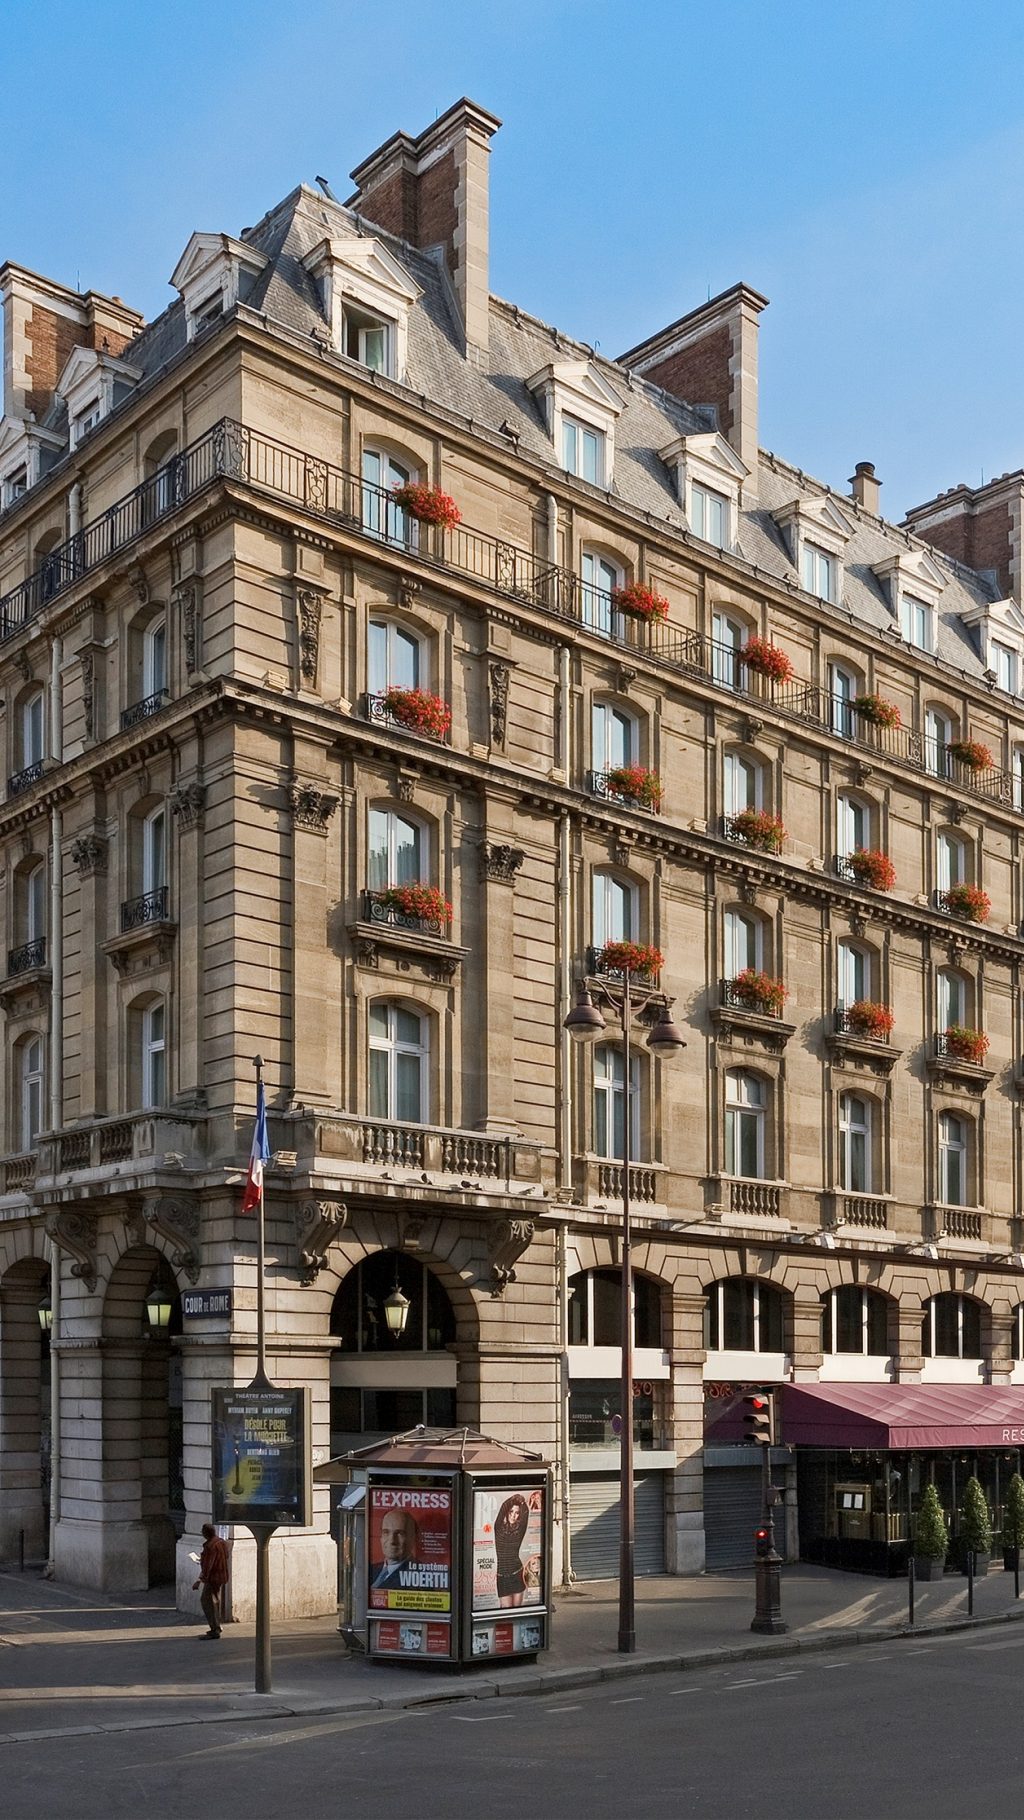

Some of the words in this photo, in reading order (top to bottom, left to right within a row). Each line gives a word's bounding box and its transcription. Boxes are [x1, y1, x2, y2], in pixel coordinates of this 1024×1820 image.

[185, 1297, 203, 1313] COUR
[210, 1295, 229, 1312] ROME
[268, 1418, 287, 1430] POUR
[372, 1491, 449, 1508] L'EXPRESS
[408, 1561, 417, 1570] Le
[418, 1562, 449, 1572] système
[399, 1571, 449, 1588] WOERTH
